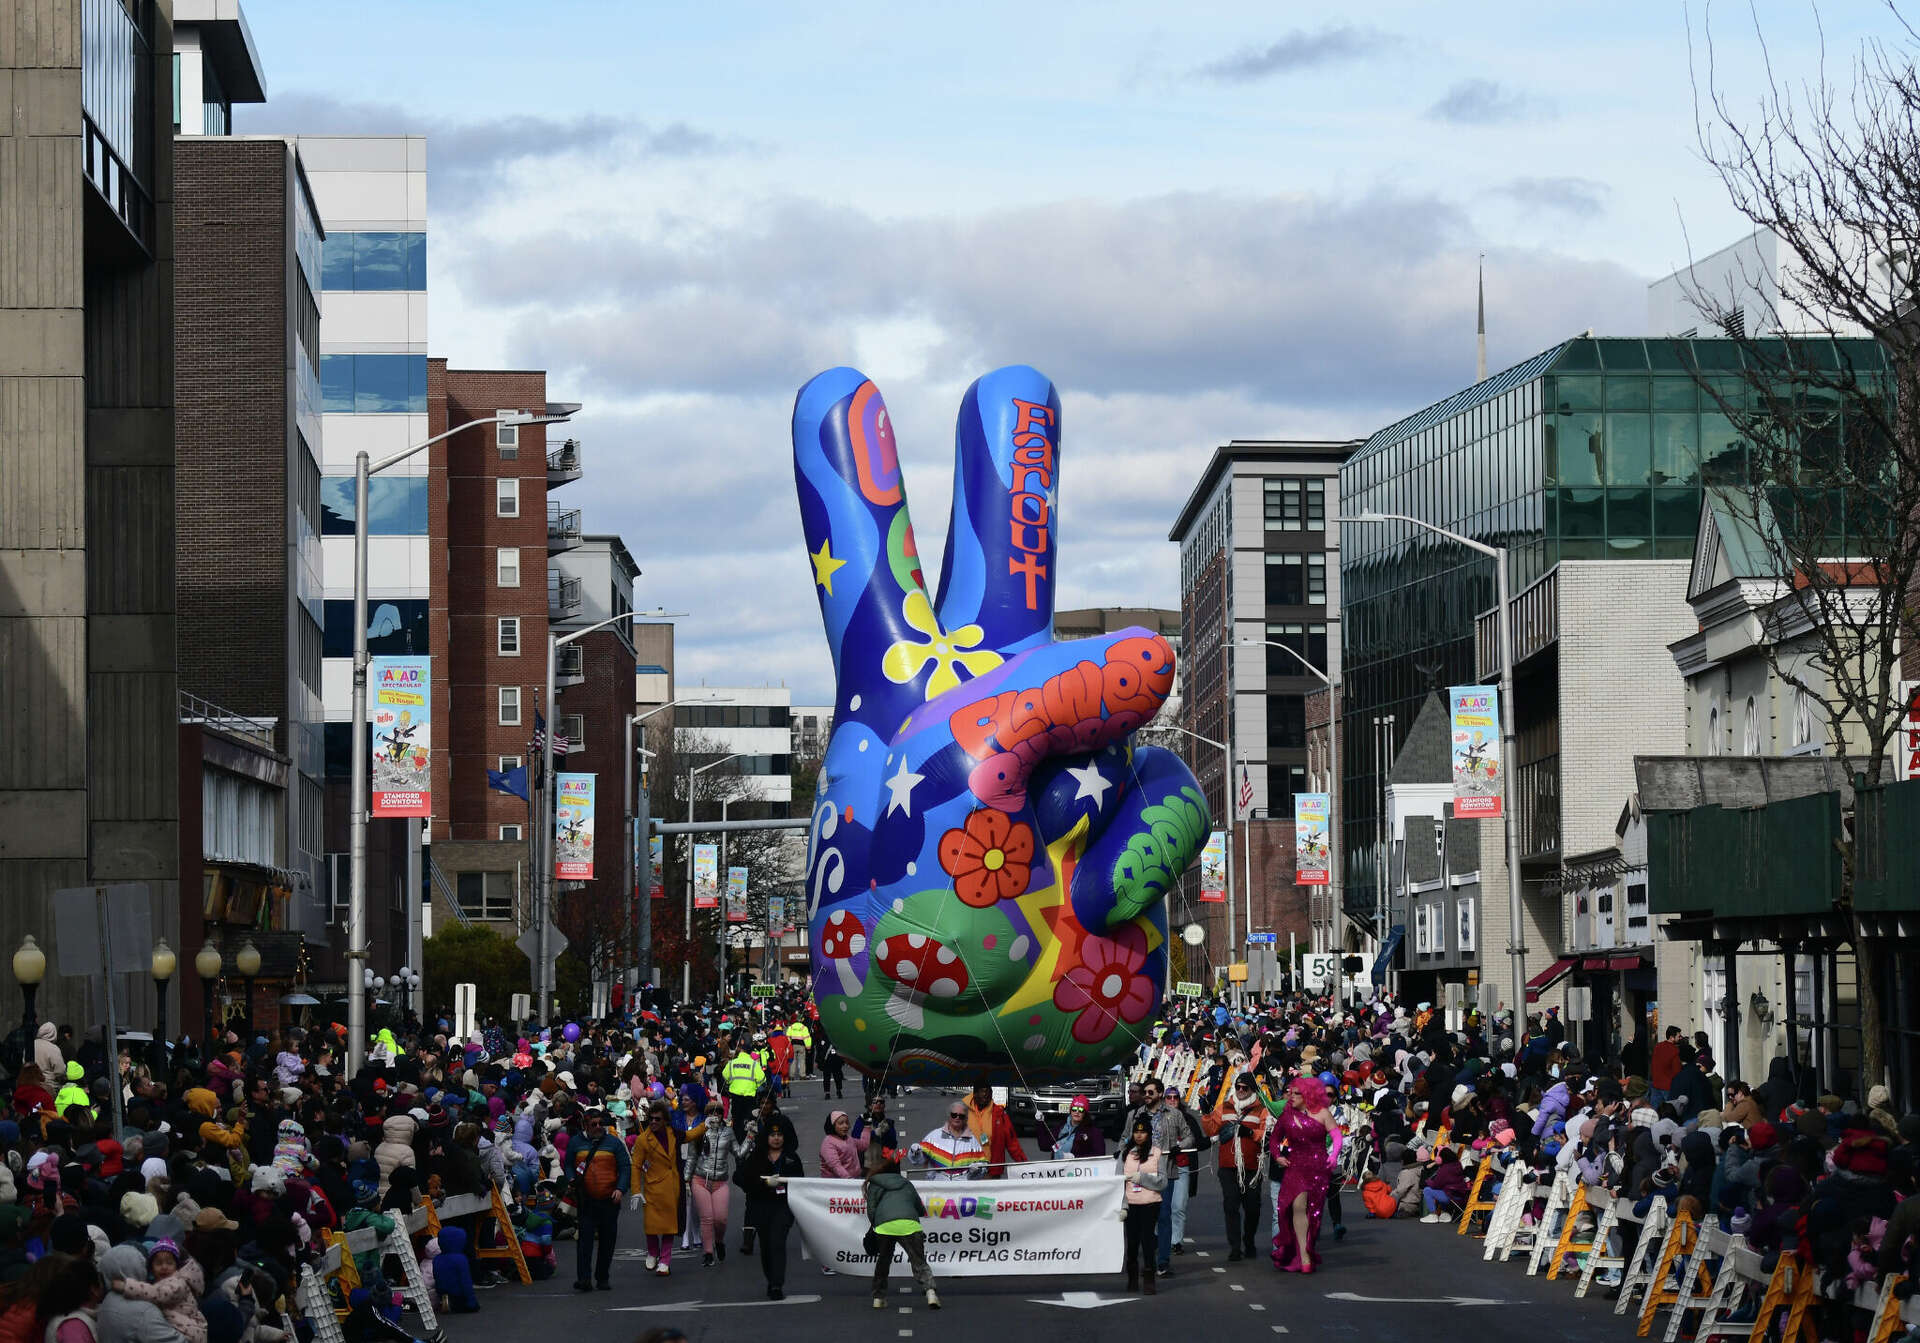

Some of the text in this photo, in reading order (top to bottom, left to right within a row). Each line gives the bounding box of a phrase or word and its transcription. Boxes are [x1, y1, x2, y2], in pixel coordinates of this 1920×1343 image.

[377, 669, 427, 682] PARADE
[950, 634, 1176, 760] FLOWER
[1454, 697, 1494, 708] PARADE
[829, 1196, 1084, 1220] STAMF RADE SPECTACULAR
[829, 1206, 866, 1214] DOWNT
[922, 1227, 1010, 1246] ace Sign
[959, 1249, 1009, 1262] PFLAG
[1013, 1248, 1081, 1262] Stamford
